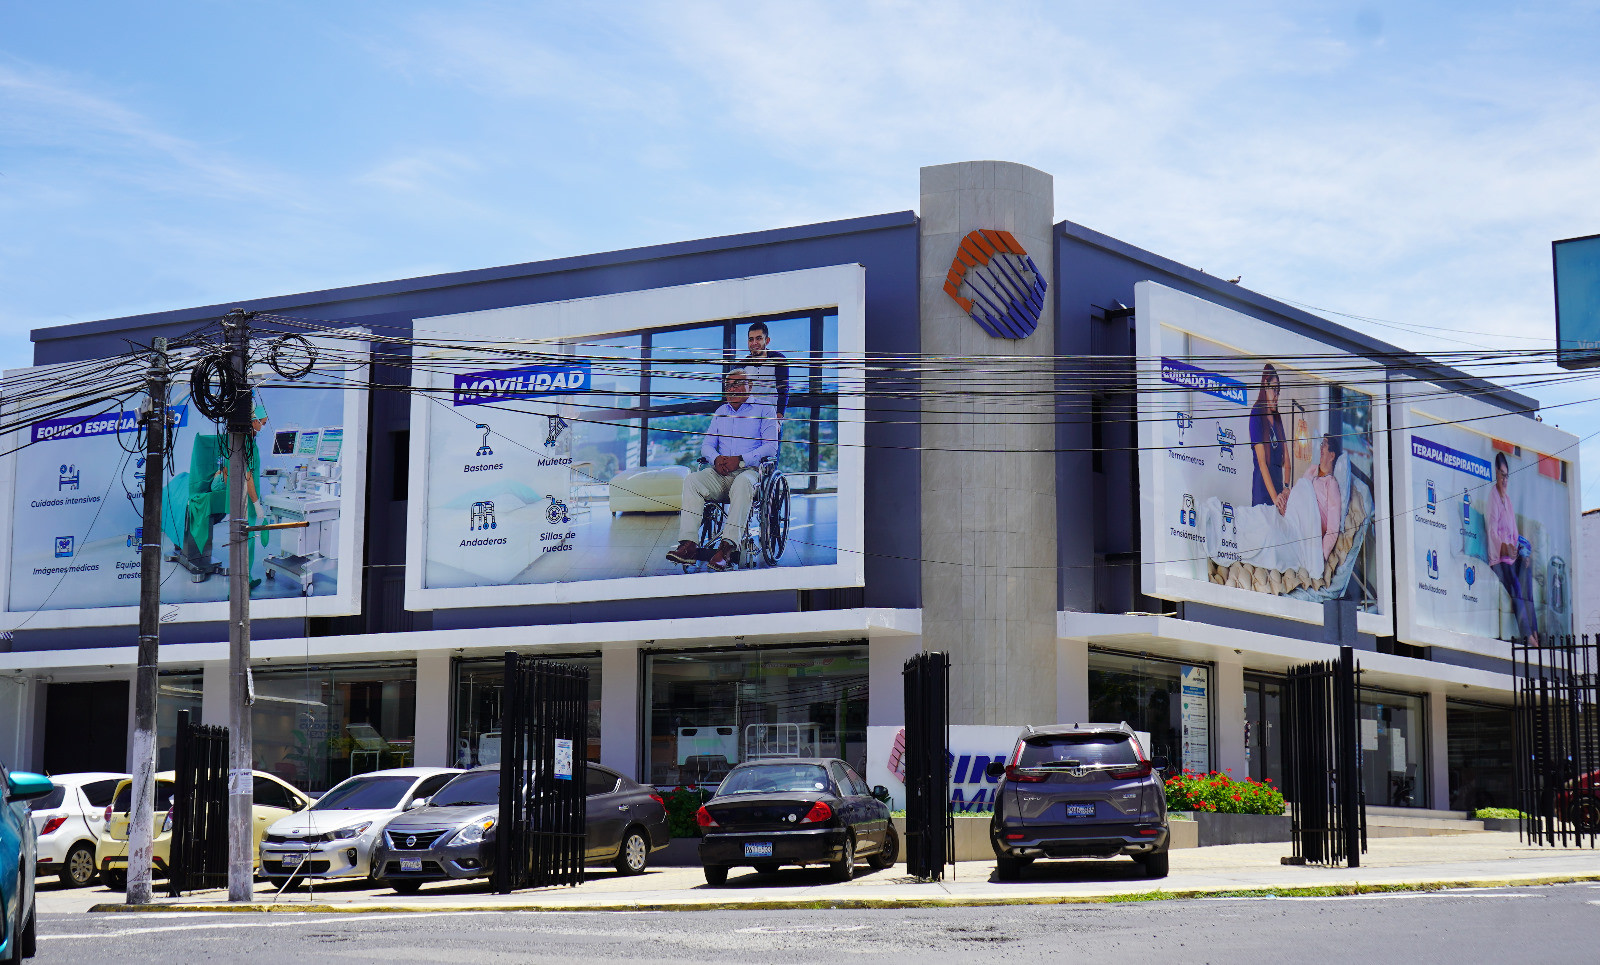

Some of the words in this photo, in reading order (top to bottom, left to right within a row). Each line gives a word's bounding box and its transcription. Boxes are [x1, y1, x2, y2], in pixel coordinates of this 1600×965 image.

[458, 370, 584, 400] MOVILIDAD
[1163, 366, 1205, 388] CUIDADO
[1221, 384, 1244, 401] CASA
[37, 425, 82, 440] EQUIPO
[85, 412, 181, 434] ESPECIALO
[537, 456, 573, 467] Muletas
[1413, 443, 1443, 463] TERAPIA
[1443, 454, 1490, 479] RESPIRATORIA
[463, 462, 503, 473] Bastones
[1217, 463, 1237, 475] Camas
[30, 496, 65, 508] Cuidados
[66, 495, 101, 506] intensivos
[1414, 514, 1447, 530] Concentradores
[459, 537, 507, 547] Andaderas
[540, 532, 563, 541] Sillas
[565, 531, 576, 540] de
[542, 543, 573, 553] ruedas
[32, 565, 68, 576] Imágenes
[68, 563, 100, 574] médicas
[118, 571, 141, 580] aneste
